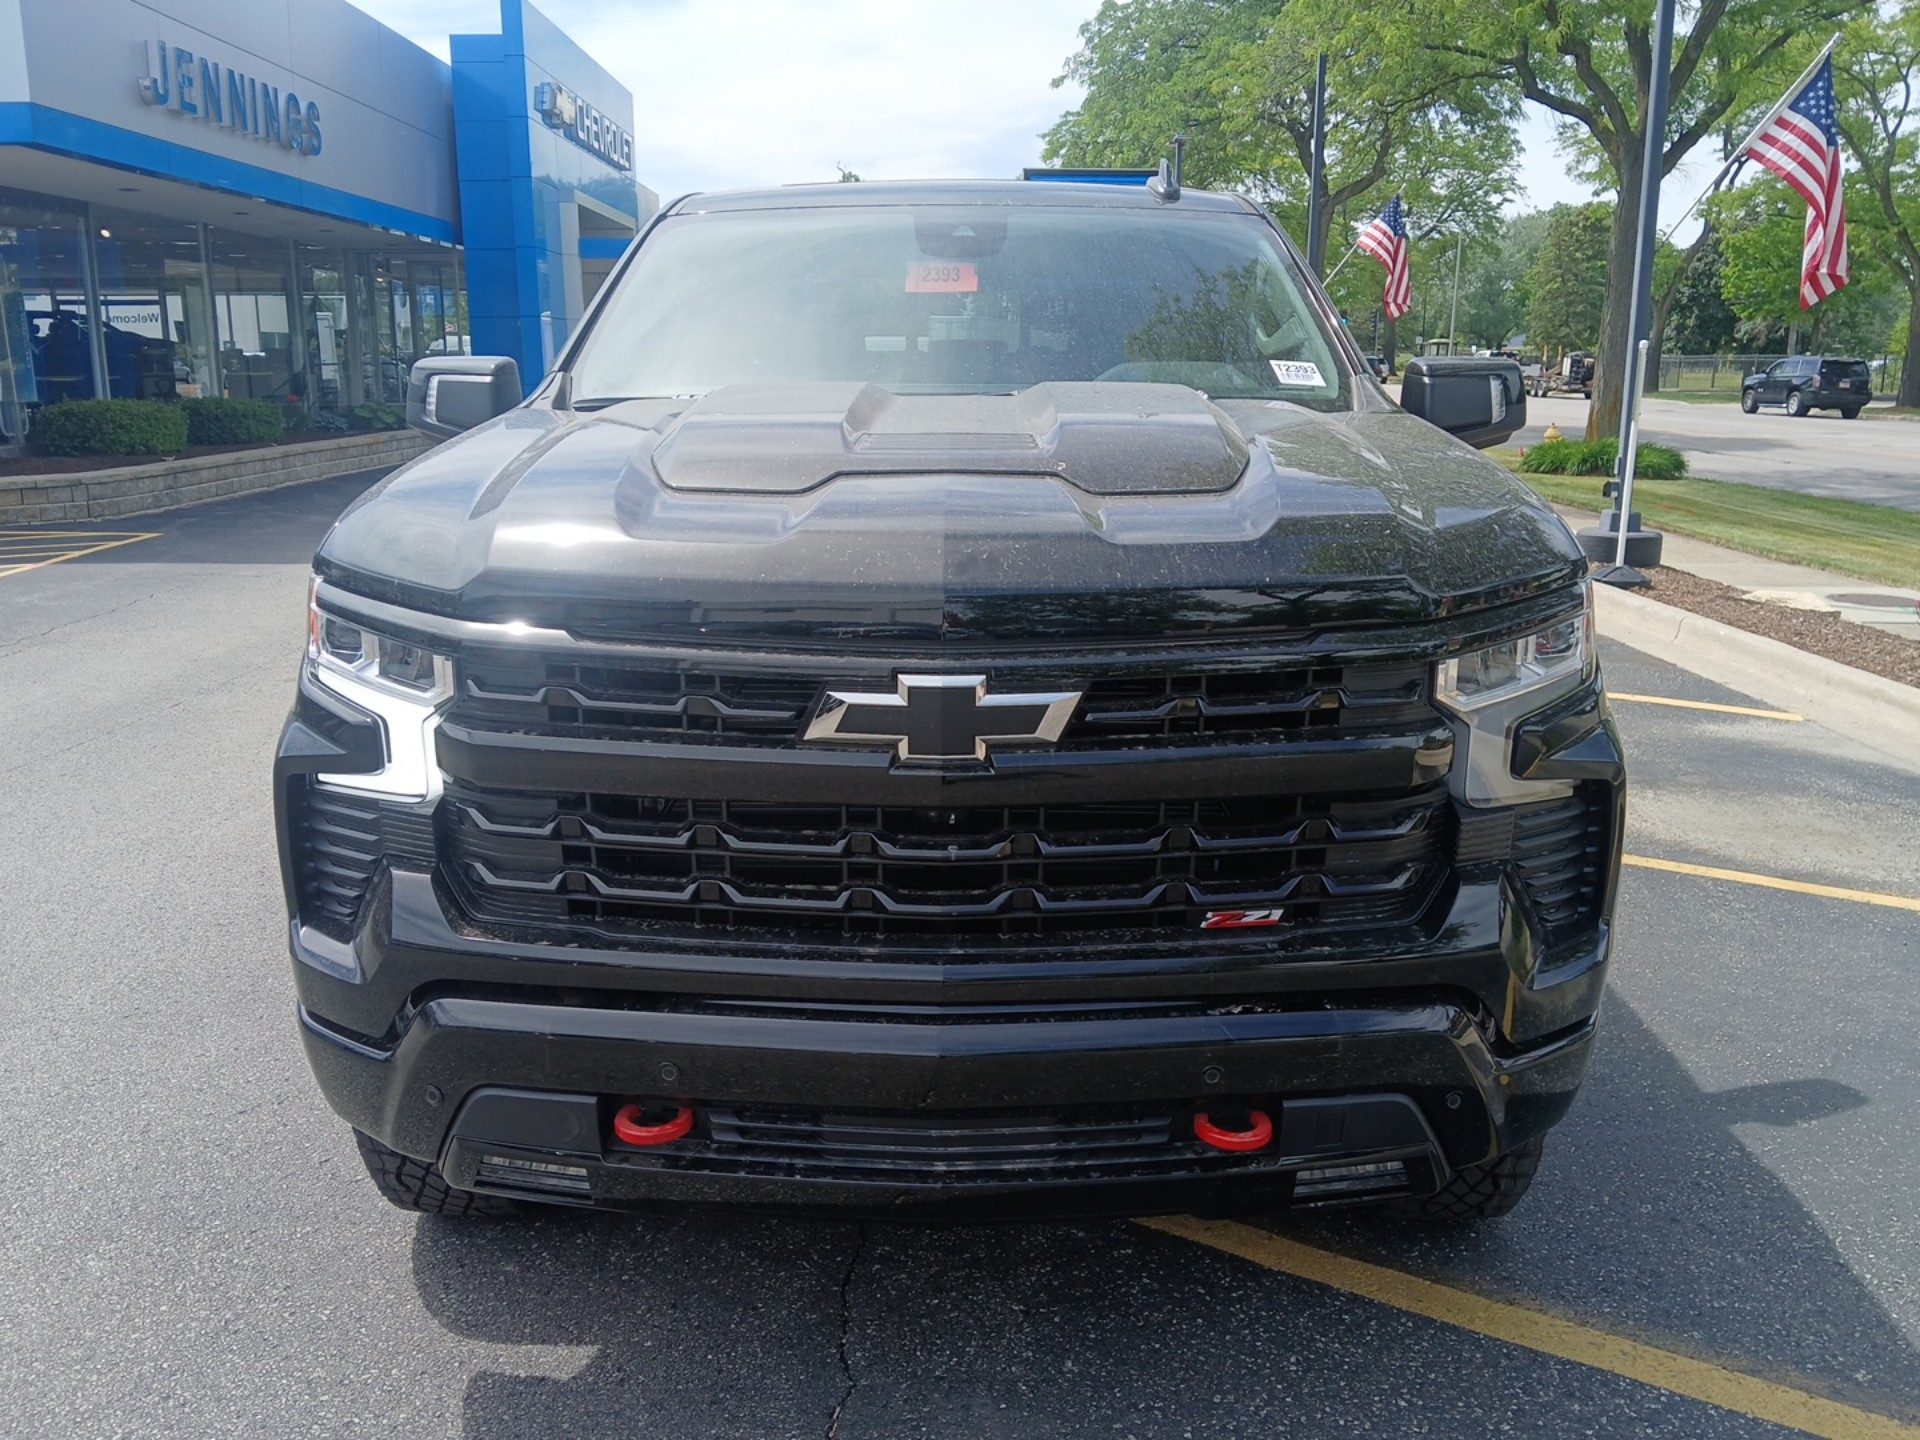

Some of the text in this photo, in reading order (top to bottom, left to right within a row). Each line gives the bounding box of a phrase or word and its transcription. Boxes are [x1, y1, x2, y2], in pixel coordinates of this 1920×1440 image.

[138, 40, 322, 156] JENNINGS
[575, 96, 634, 170] CHEVROLET
[922, 266, 960, 282] 2393
[1200, 909, 1284, 928] Z71
